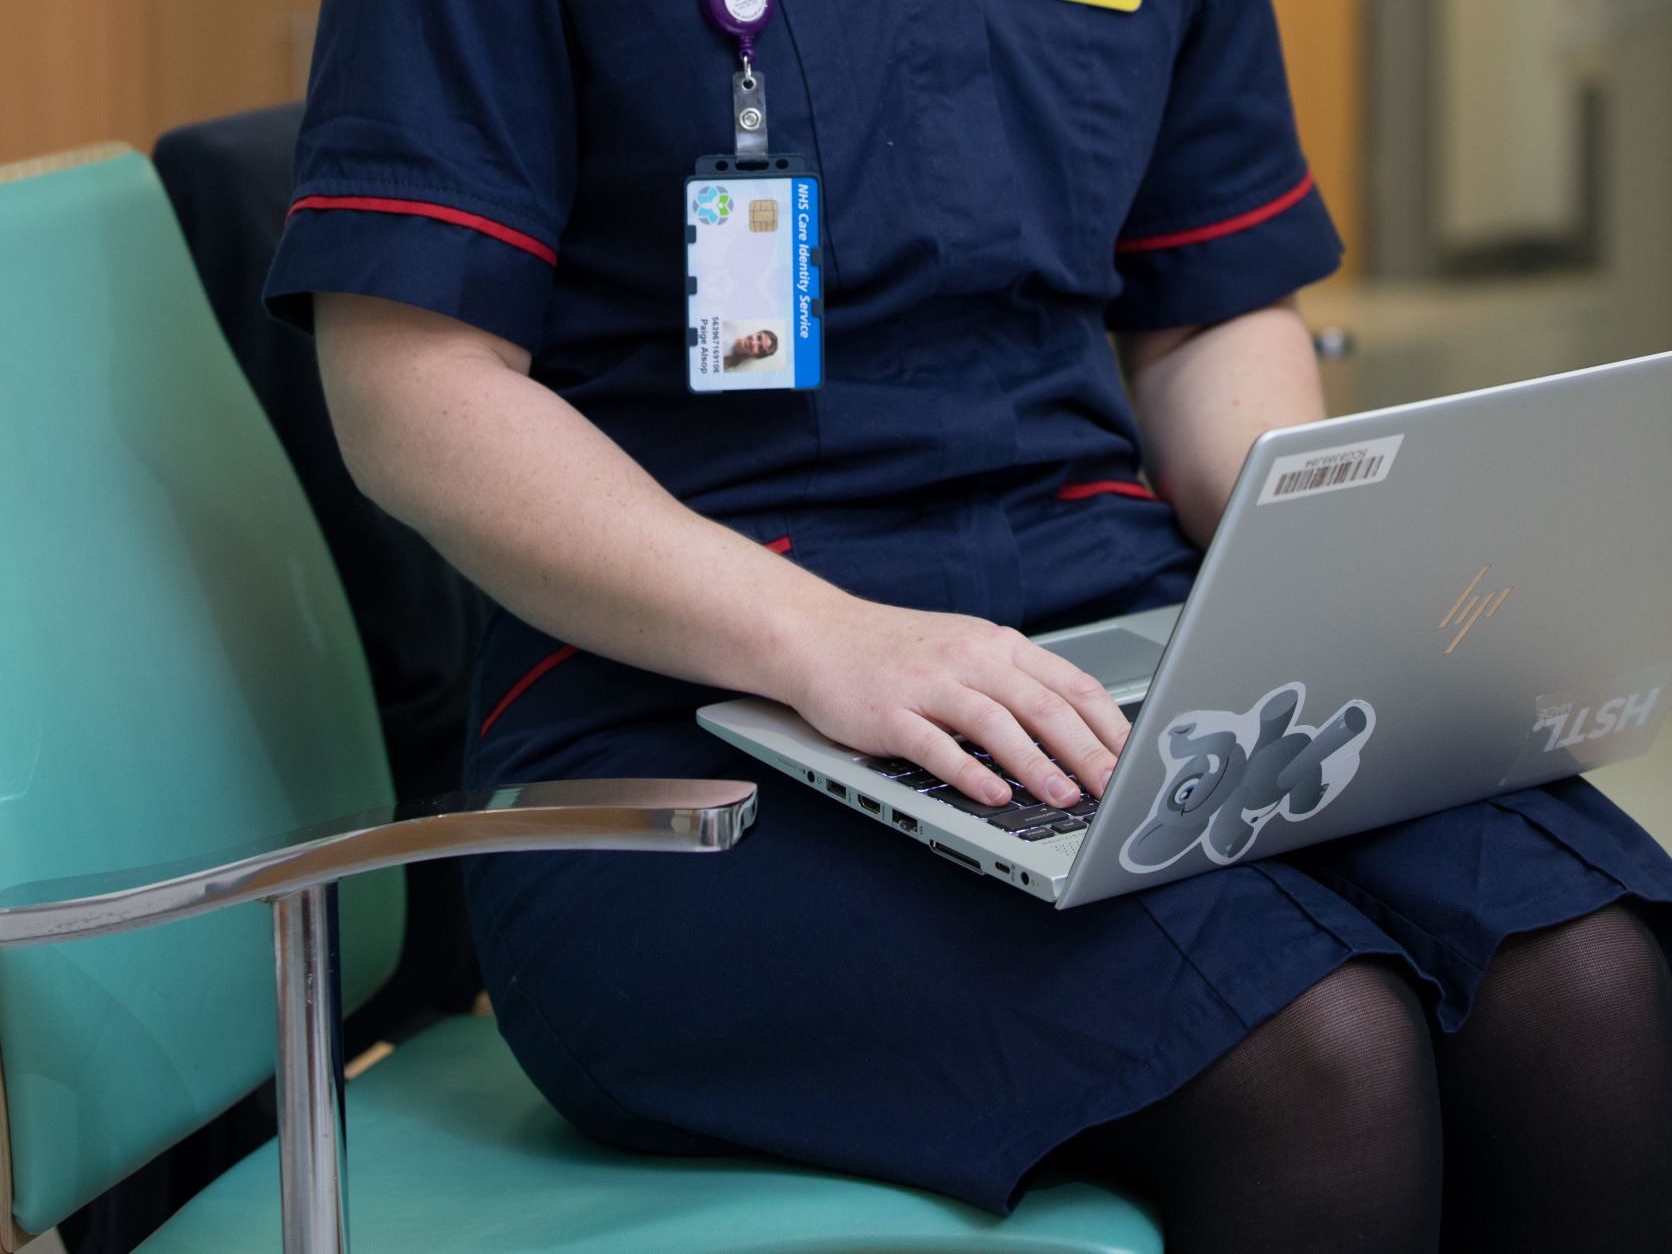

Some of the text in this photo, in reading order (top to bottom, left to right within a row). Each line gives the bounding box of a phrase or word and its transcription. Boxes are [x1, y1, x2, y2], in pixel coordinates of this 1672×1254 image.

[797, 183, 811, 339] NHS Care Identity Service
[699, 318, 709, 375] Paige Alsop
[1438, 564, 1513, 656] hp
